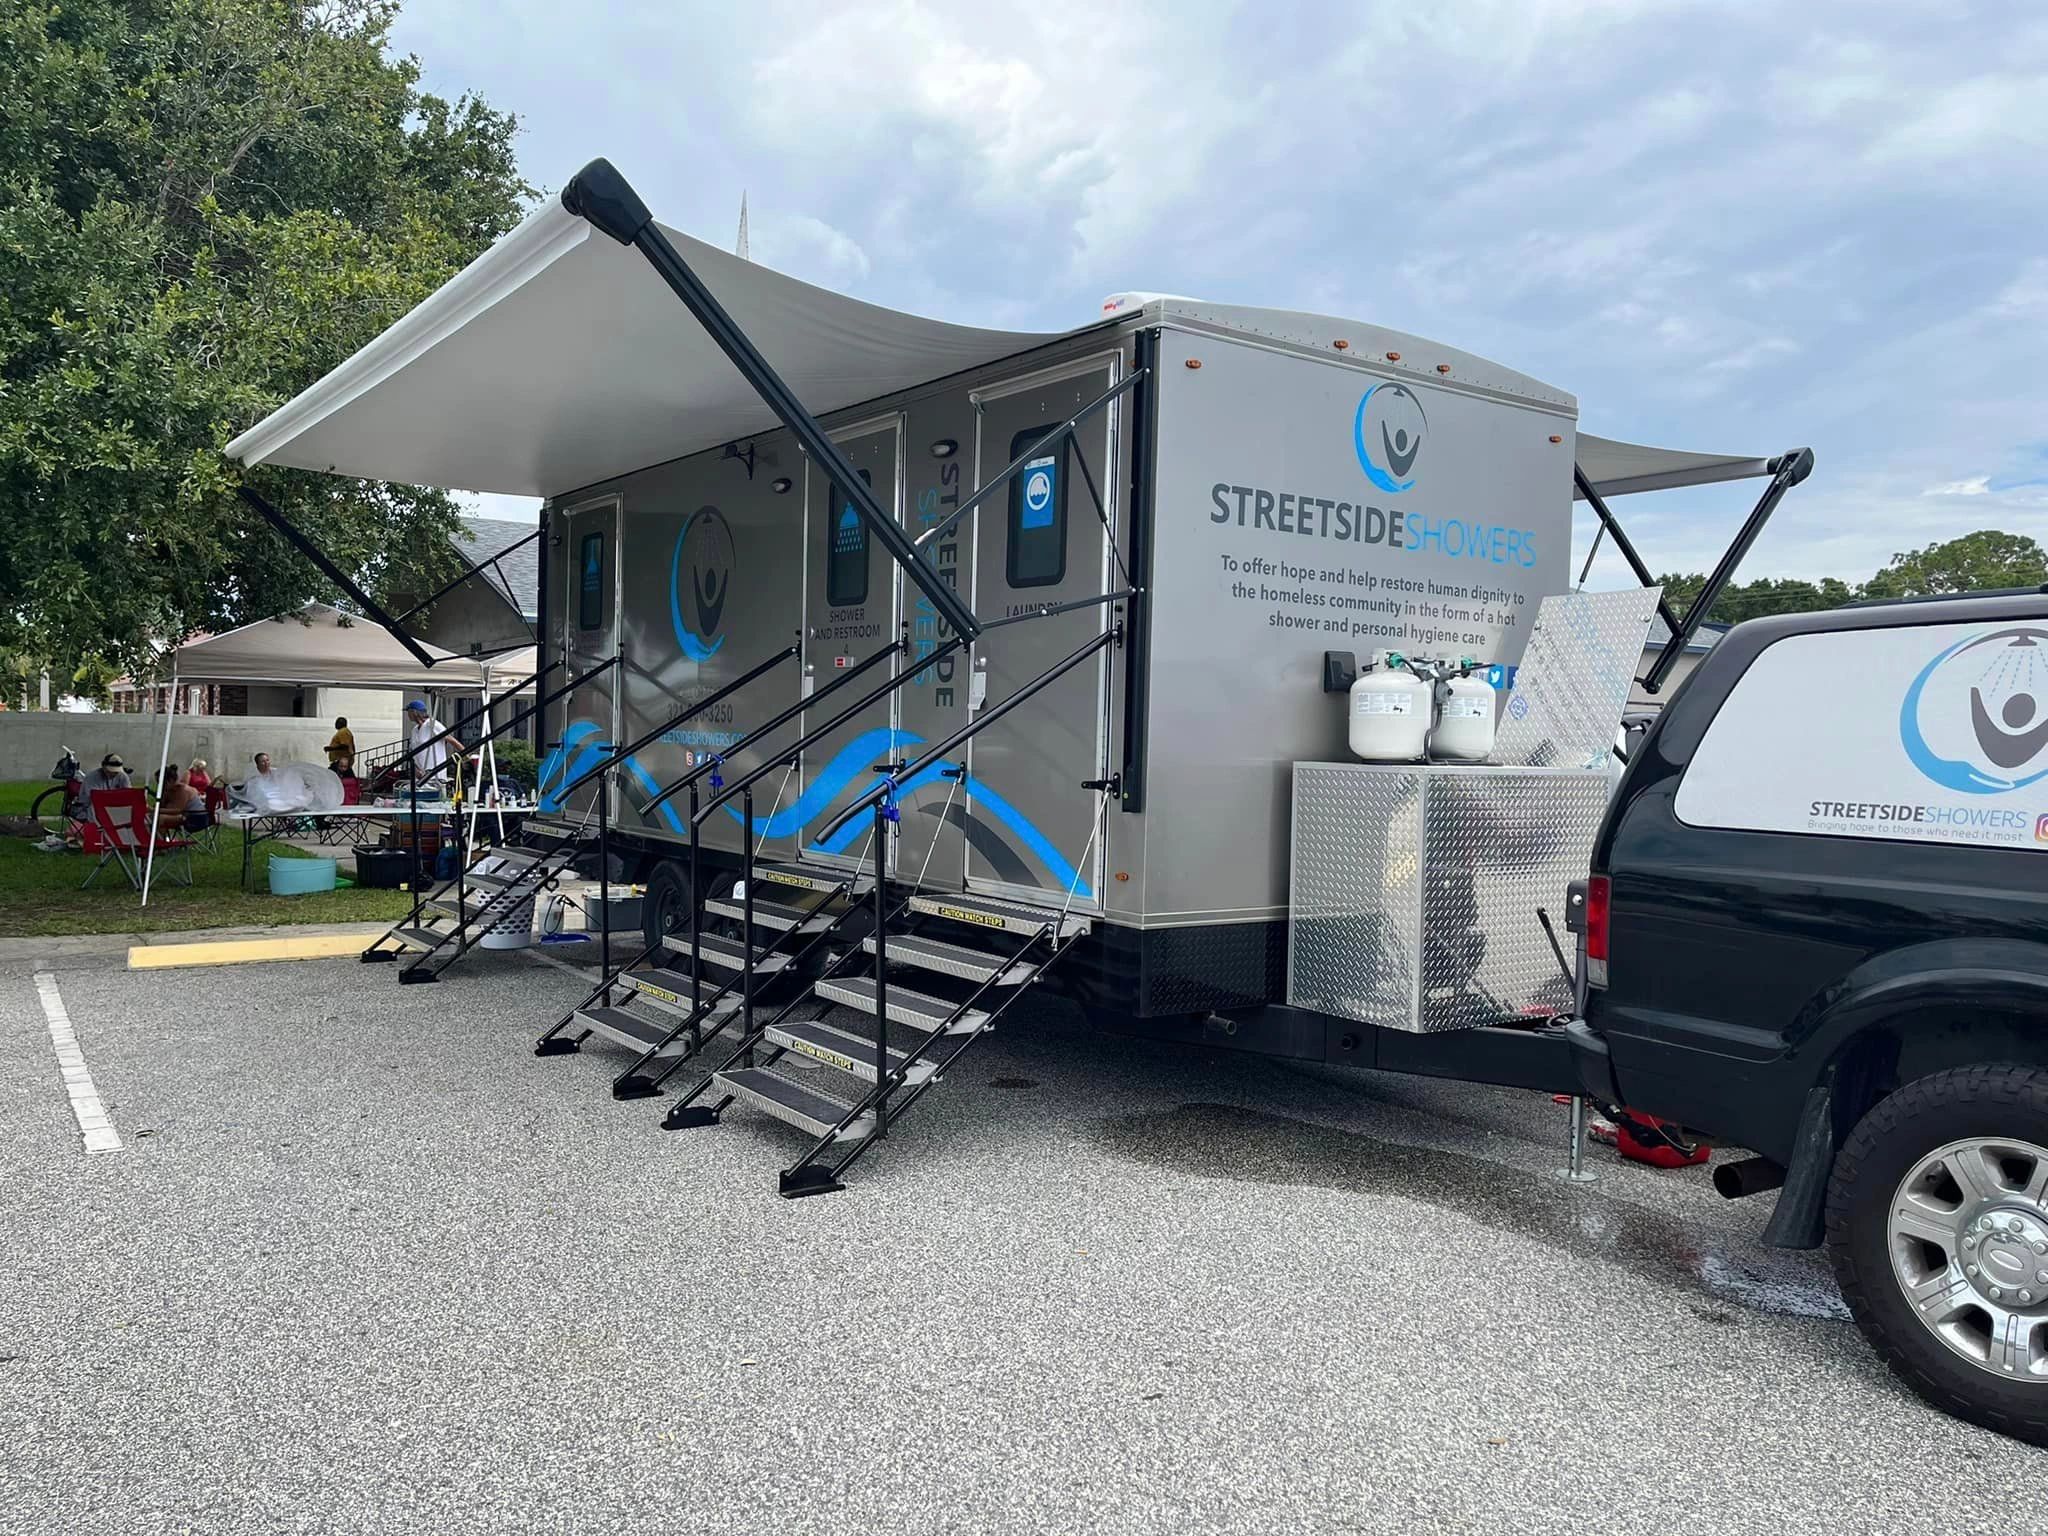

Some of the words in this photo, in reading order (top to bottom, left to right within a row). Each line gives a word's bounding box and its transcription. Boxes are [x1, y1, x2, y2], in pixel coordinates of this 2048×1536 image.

[1221, 554, 1238, 571] To
[1242, 557, 1277, 576] offer
[1280, 560, 1315, 583] hope
[1319, 568, 1344, 583] and
[1348, 569, 1377, 591] help
[1380, 577, 1424, 593] restore
[1428, 578, 1467, 598] human
[1471, 585, 1510, 606] dignity
[1513, 591, 1525, 605] to
[830, 608, 865, 623] SHOWER
[1232, 581, 1256, 599] the
[1260, 583, 1326, 606] homeless
[1329, 596, 1401, 618] community
[1404, 600, 1416, 615] in
[1419, 602, 1439, 618] the
[1442, 603, 1470, 621] form
[1473, 608, 1485, 622] of
[1487, 613, 1494, 624] a
[1497, 611, 1516, 626] hot
[834, 624, 880, 639] RESTROOM
[1269, 610, 1320, 630] shower
[1323, 617, 1348, 633] and
[1352, 621, 1407, 638] personal
[1411, 623, 1459, 644] hygiene
[1462, 633, 1486, 645] care
[1808, 820, 1847, 832] Bringing
[1850, 822, 1874, 833] hope
[1878, 824, 1889, 833] to
[1893, 825, 1923, 835] those
[1926, 827, 1948, 837] who
[1951, 829, 1978, 839] need
[1982, 831, 1989, 840] it
[1991, 833, 2023, 842] most
